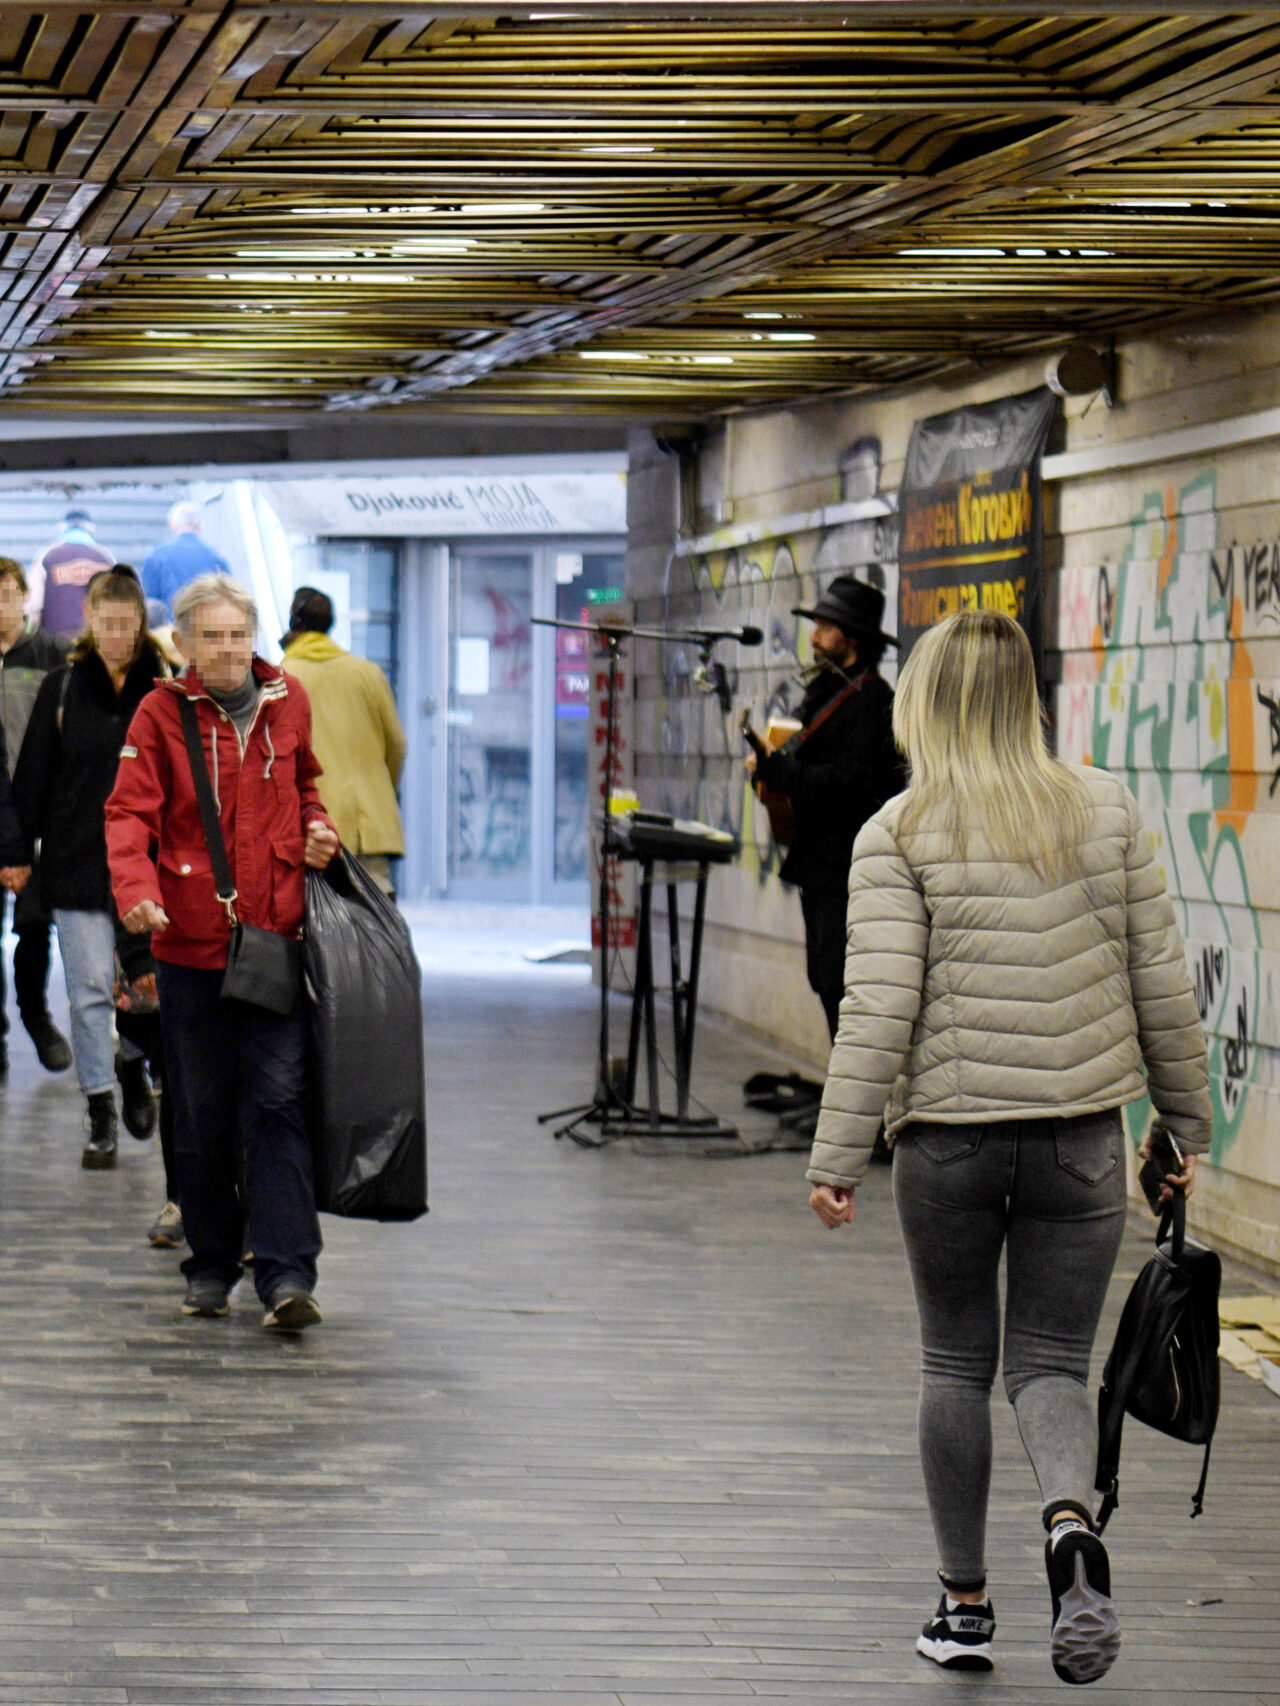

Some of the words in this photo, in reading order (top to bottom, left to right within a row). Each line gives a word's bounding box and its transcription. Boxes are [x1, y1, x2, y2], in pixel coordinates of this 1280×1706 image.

[347, 490, 463, 516] Djoković
[466, 482, 544, 511] MOJA
[958, 1619, 984, 1631] NIKE
